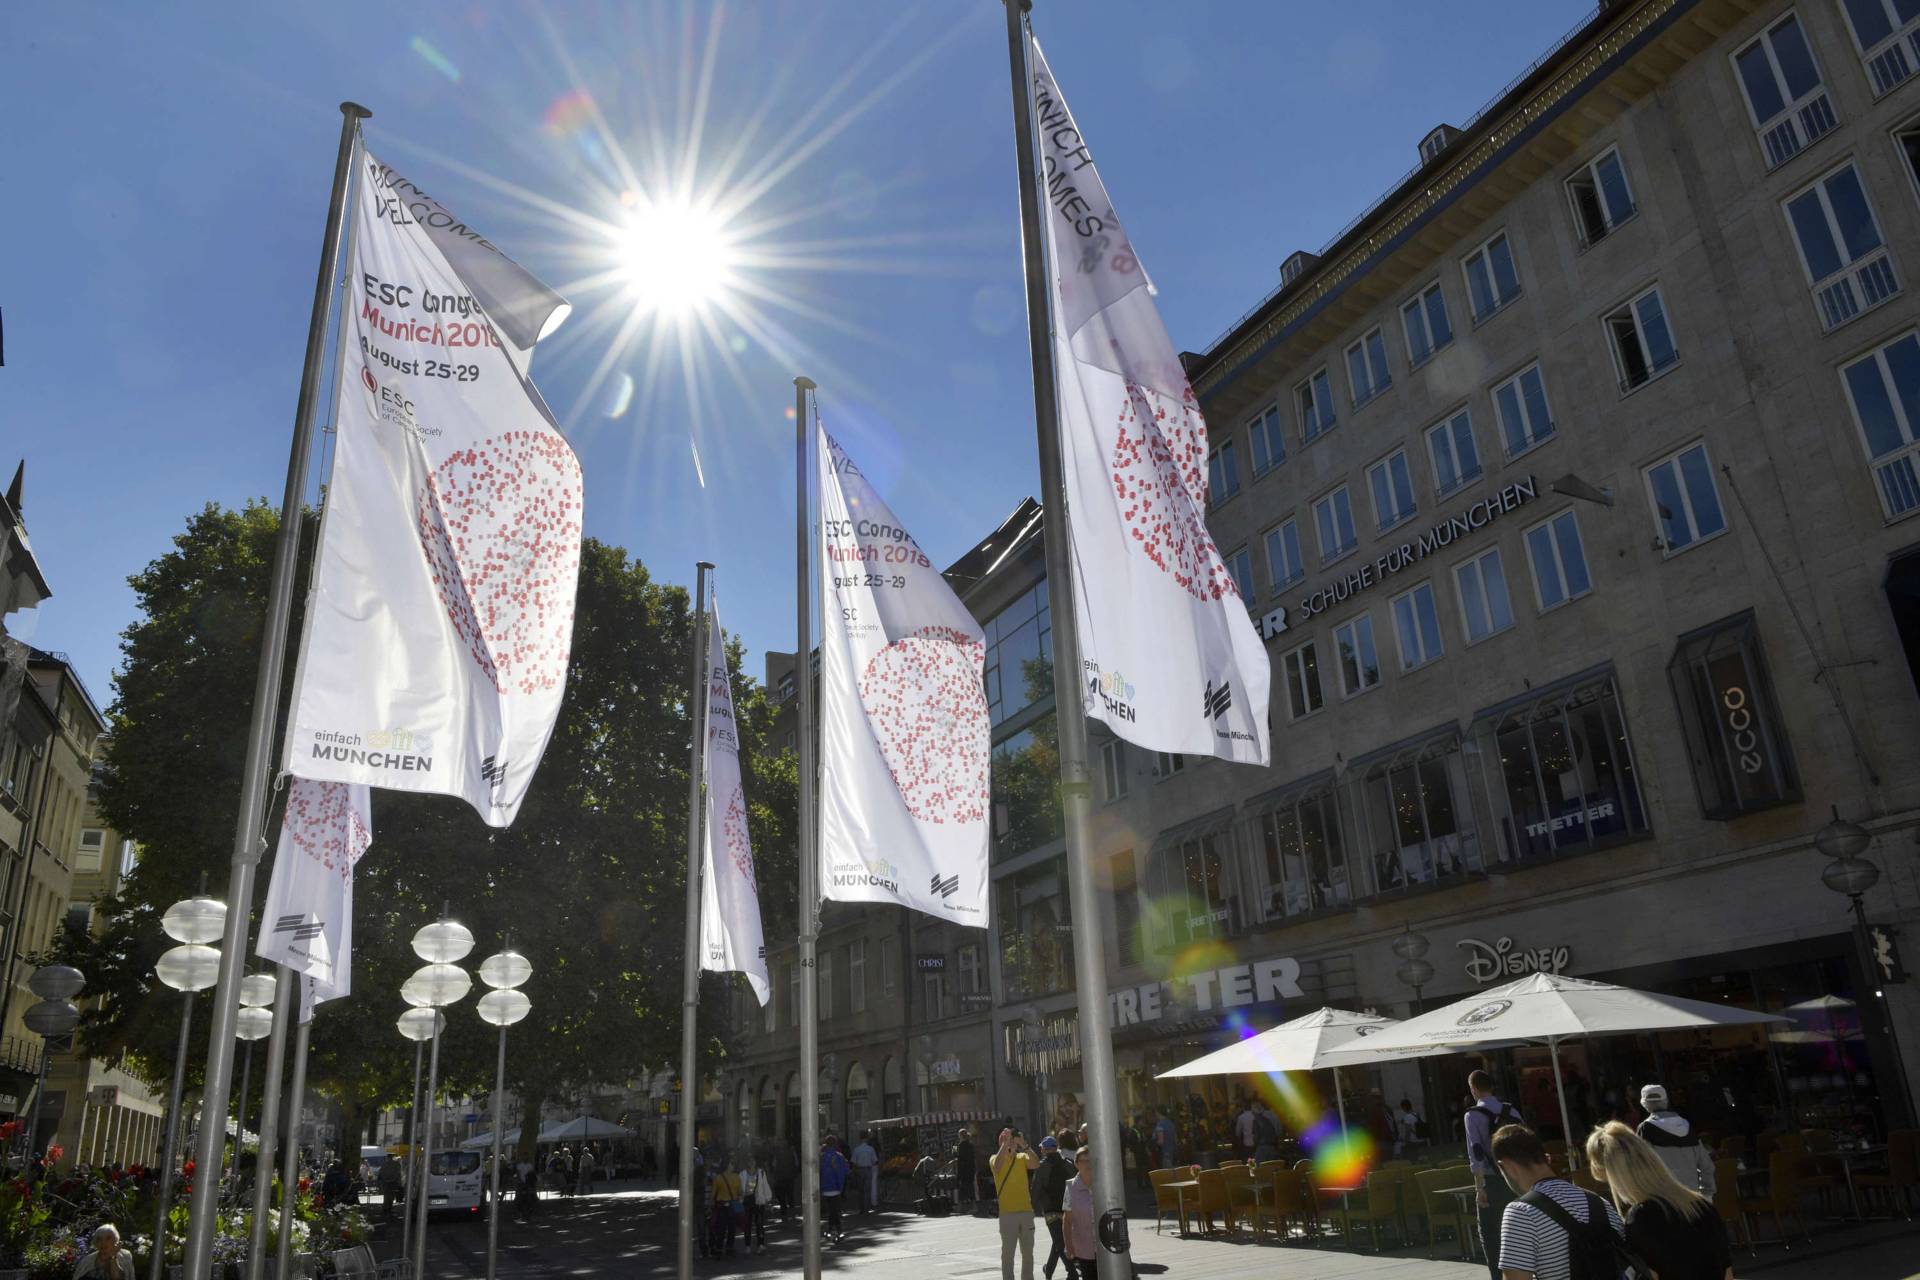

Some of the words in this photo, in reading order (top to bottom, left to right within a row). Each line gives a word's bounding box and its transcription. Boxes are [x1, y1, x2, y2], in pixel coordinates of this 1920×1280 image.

[364, 272, 413, 308] ESC
[362, 297, 444, 347] Munich
[361, 336, 419, 376] August
[424, 360, 480, 381] 25-29
[381, 386, 415, 416] ESC
[1300, 564, 1372, 619] SCHUHE
[1376, 543, 1414, 579] FÜR
[1418, 475, 1537, 557] MÜNCHEN
[863, 574, 906, 589] 25-29
[315, 730, 361, 746] einfach
[1723, 686, 1762, 773] ecco
[312, 743, 433, 773] MÜNCHEN
[1525, 803, 1615, 837] TRETTER
